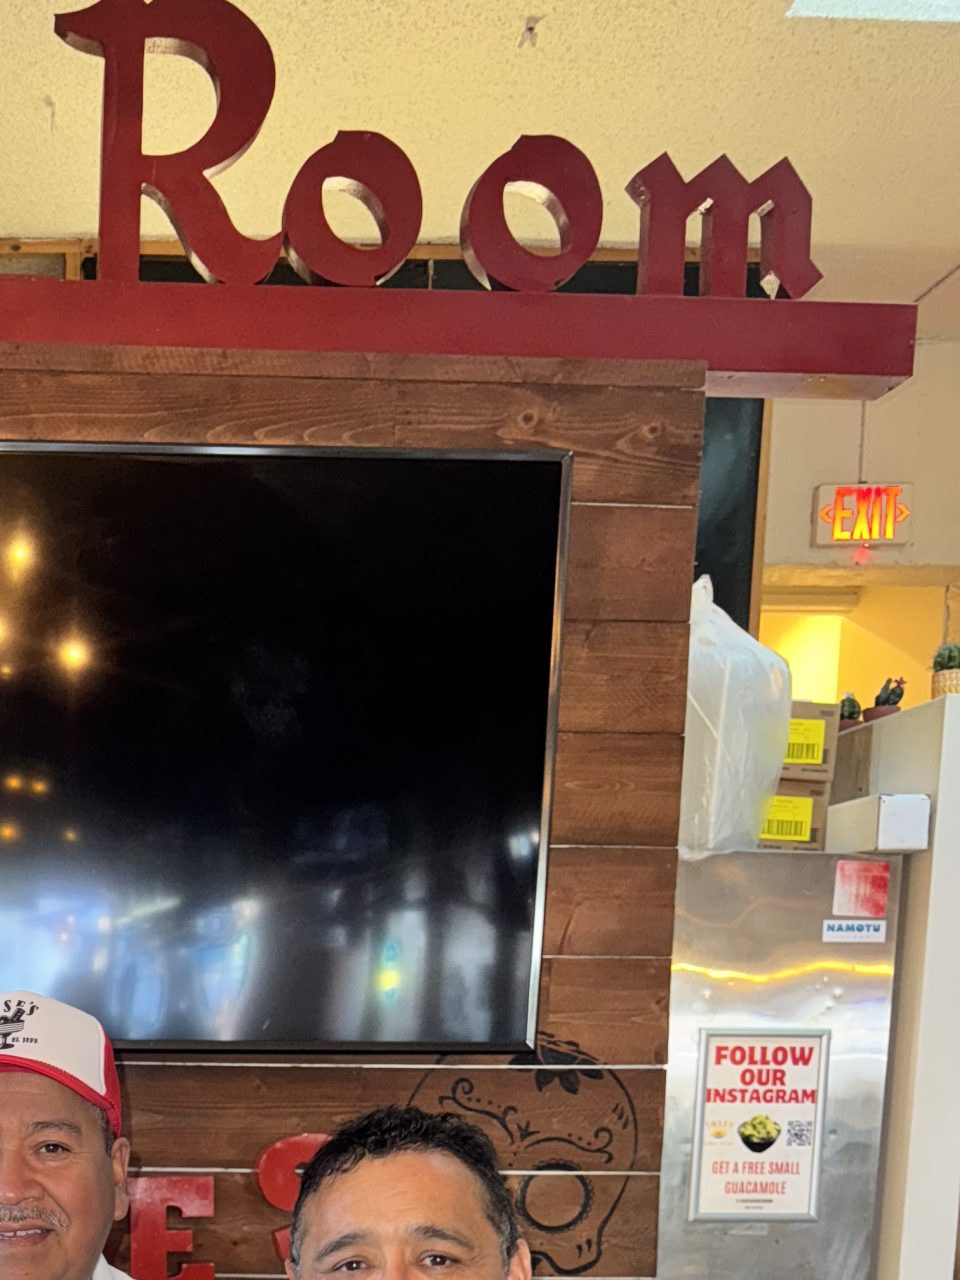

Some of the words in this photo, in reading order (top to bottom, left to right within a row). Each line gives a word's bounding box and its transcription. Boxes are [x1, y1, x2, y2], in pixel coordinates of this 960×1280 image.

[53, 0, 824, 301] Room
[833, 486, 902, 541] EXIT
[827, 923, 881, 932] NAMOTU
[714, 1045, 815, 1066] FOLLOW
[740, 1068, 786, 1086] OUR
[705, 1087, 818, 1104] INSTAGRAM
[712, 1161, 729, 1175] GET
[731, 1161, 739, 1175] A
[742, 1161, 765, 1175] FREE
[768, 1161, 801, 1176] SMALL
[724, 1181, 787, 1195] GUACAMOLE
